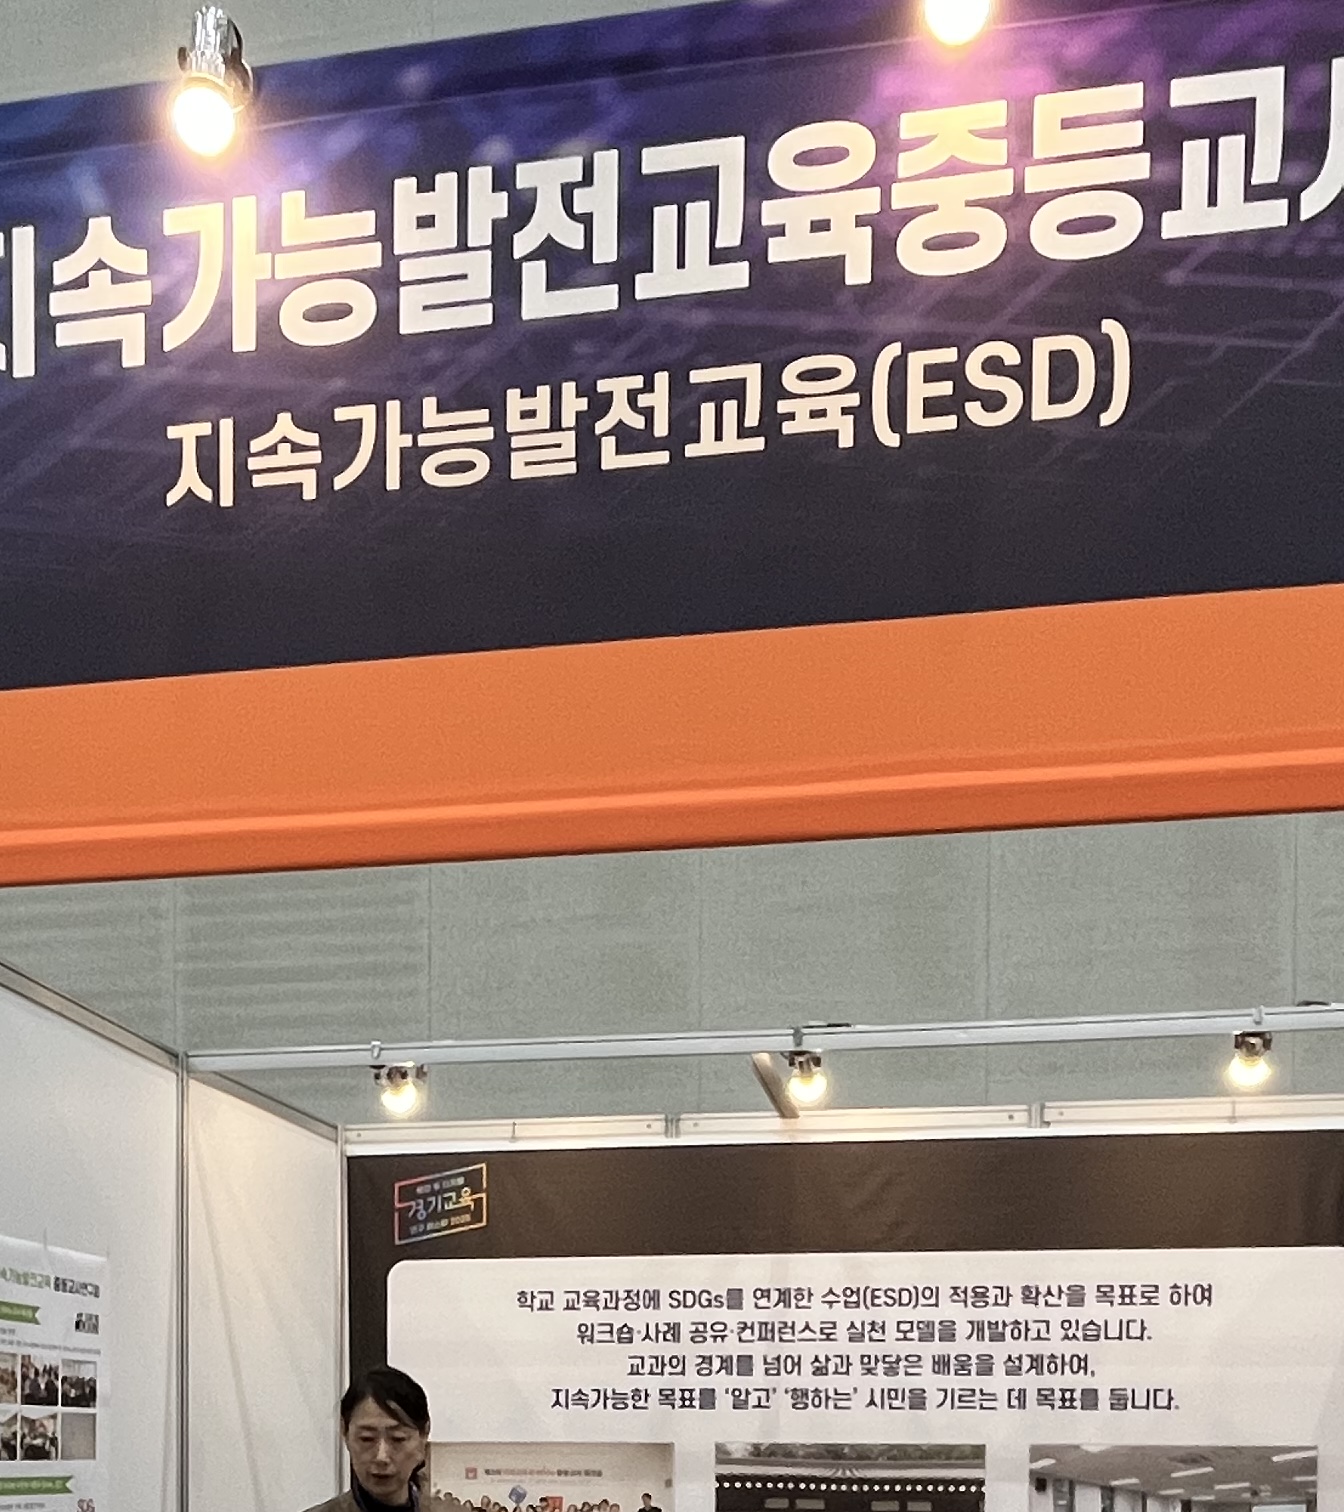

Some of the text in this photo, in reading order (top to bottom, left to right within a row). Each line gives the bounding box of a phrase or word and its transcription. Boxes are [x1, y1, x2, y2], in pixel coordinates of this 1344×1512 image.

[164, 318, 1131, 508] 지속가능발전교육(ESD)
[517, 1283, 1212, 1312] 학교 교육과정에 SDGs를 연계한 수업(ESD)의 적용과 확산을 목표로 하여
[846, 1320, 886, 1343] 실천
[895, 1319, 956, 1343] 모델을
[966, 1319, 1050, 1342] 개발하고
[1060, 1319, 1152, 1342] 있습니다.
[627, 1353, 1096, 1377] 교과의 경계를 넘어 삶과 맞닿은 배움을 설계하여,
[551, 1388, 650, 1410] 지속가능한
[658, 1388, 715, 1410] 목표를
[864, 1387, 928, 1410] 시민을
[936, 1387, 998, 1410] 기르는
[1007, 1388, 1027, 1410] 데
[1035, 1388, 1099, 1410] 목표를
[1108, 1387, 1180, 1410] 둡니다.
